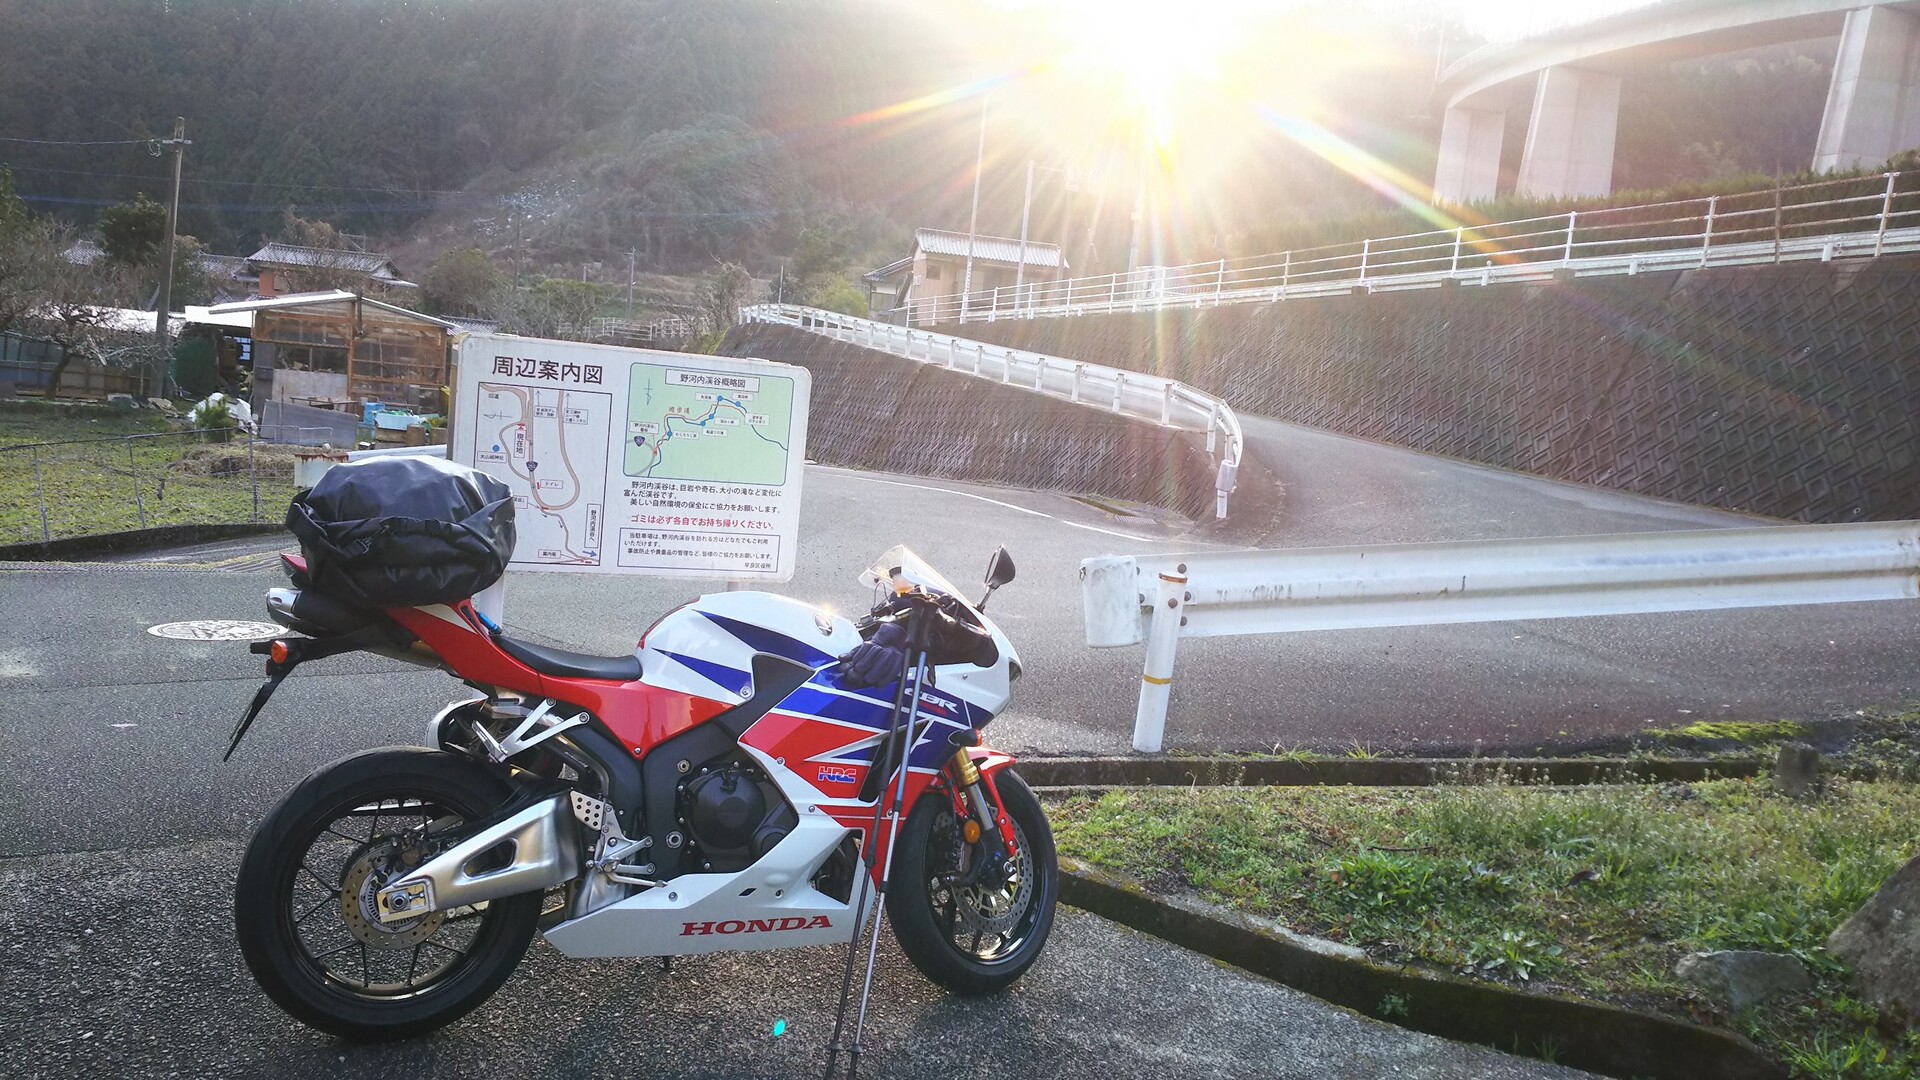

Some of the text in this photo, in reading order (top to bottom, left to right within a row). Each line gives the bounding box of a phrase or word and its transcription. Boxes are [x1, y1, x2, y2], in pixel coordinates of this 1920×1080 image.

[492, 355, 603, 385] 周辺案内図
[680, 373, 746, 388] 野河内渓谷概略図
[516, 433, 524, 454] 現在地
[624, 489, 677, 499] 富んだ渓谷です。
[631, 481, 782, 497] 野河内渓谷は、巨岩や奇石、大小の滝など変化に
[630, 498, 781, 513] 美しい自然環境の保全にご協力をお願いします。
[630, 514, 774, 530] ゴミは必ず各自でお持ち帰りください。
[624, 540, 661, 548] いただけます。
[817, 765, 857, 784] HRC
[679, 915, 833, 936] HONDA
